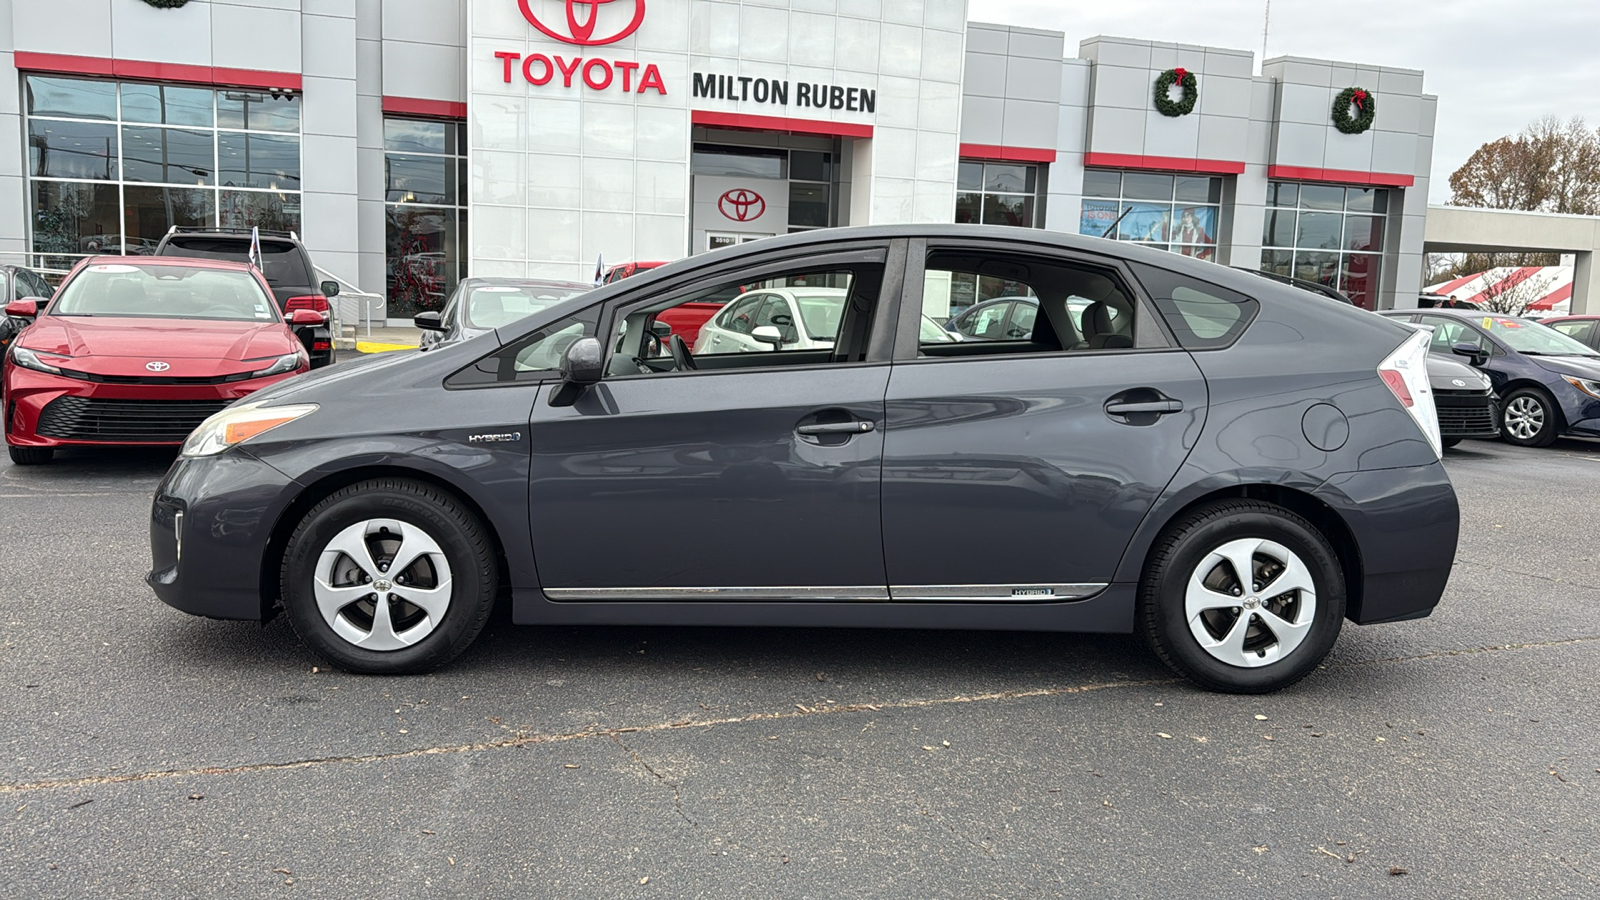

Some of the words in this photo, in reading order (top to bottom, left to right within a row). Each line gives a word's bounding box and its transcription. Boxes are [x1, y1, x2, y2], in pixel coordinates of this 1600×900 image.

[494, 51, 667, 95] TOYOTA
[693, 72, 789, 105] MILTON
[796, 82, 876, 113] RUBEN
[469, 433, 513, 442] HYBRID
[381, 497, 446, 530] GENERAL
